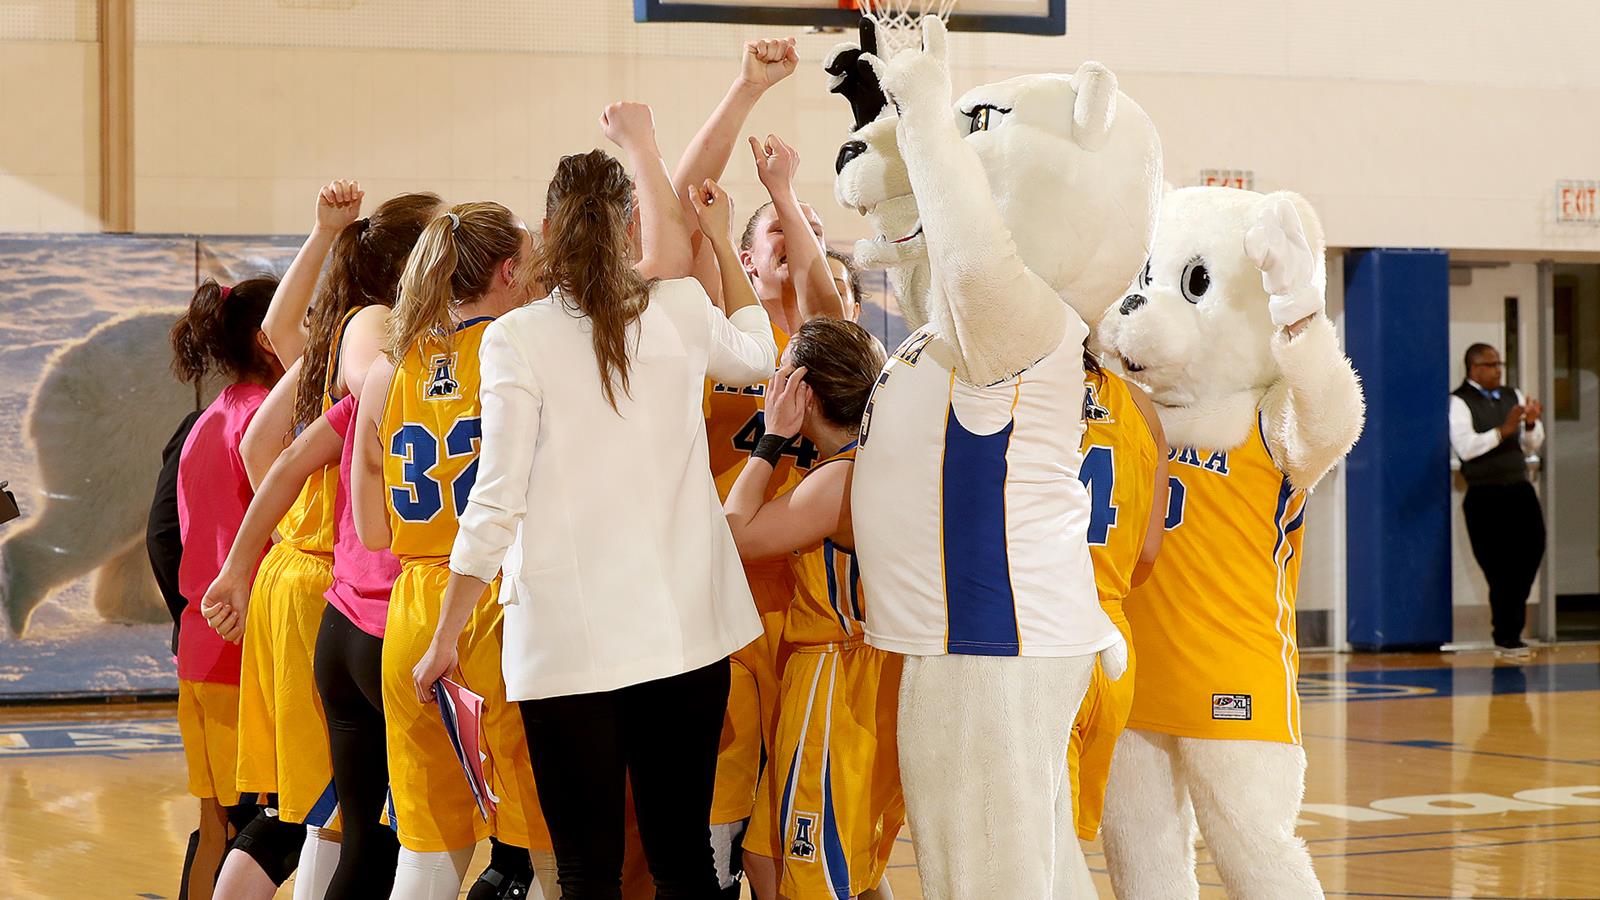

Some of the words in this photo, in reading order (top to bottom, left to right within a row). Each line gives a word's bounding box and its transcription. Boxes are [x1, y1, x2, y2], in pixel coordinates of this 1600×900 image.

[1561, 187, 1597, 219] EXIT
[730, 408, 820, 471] 44
[389, 415, 483, 523] 32
[1233, 699, 1246, 708] XL
